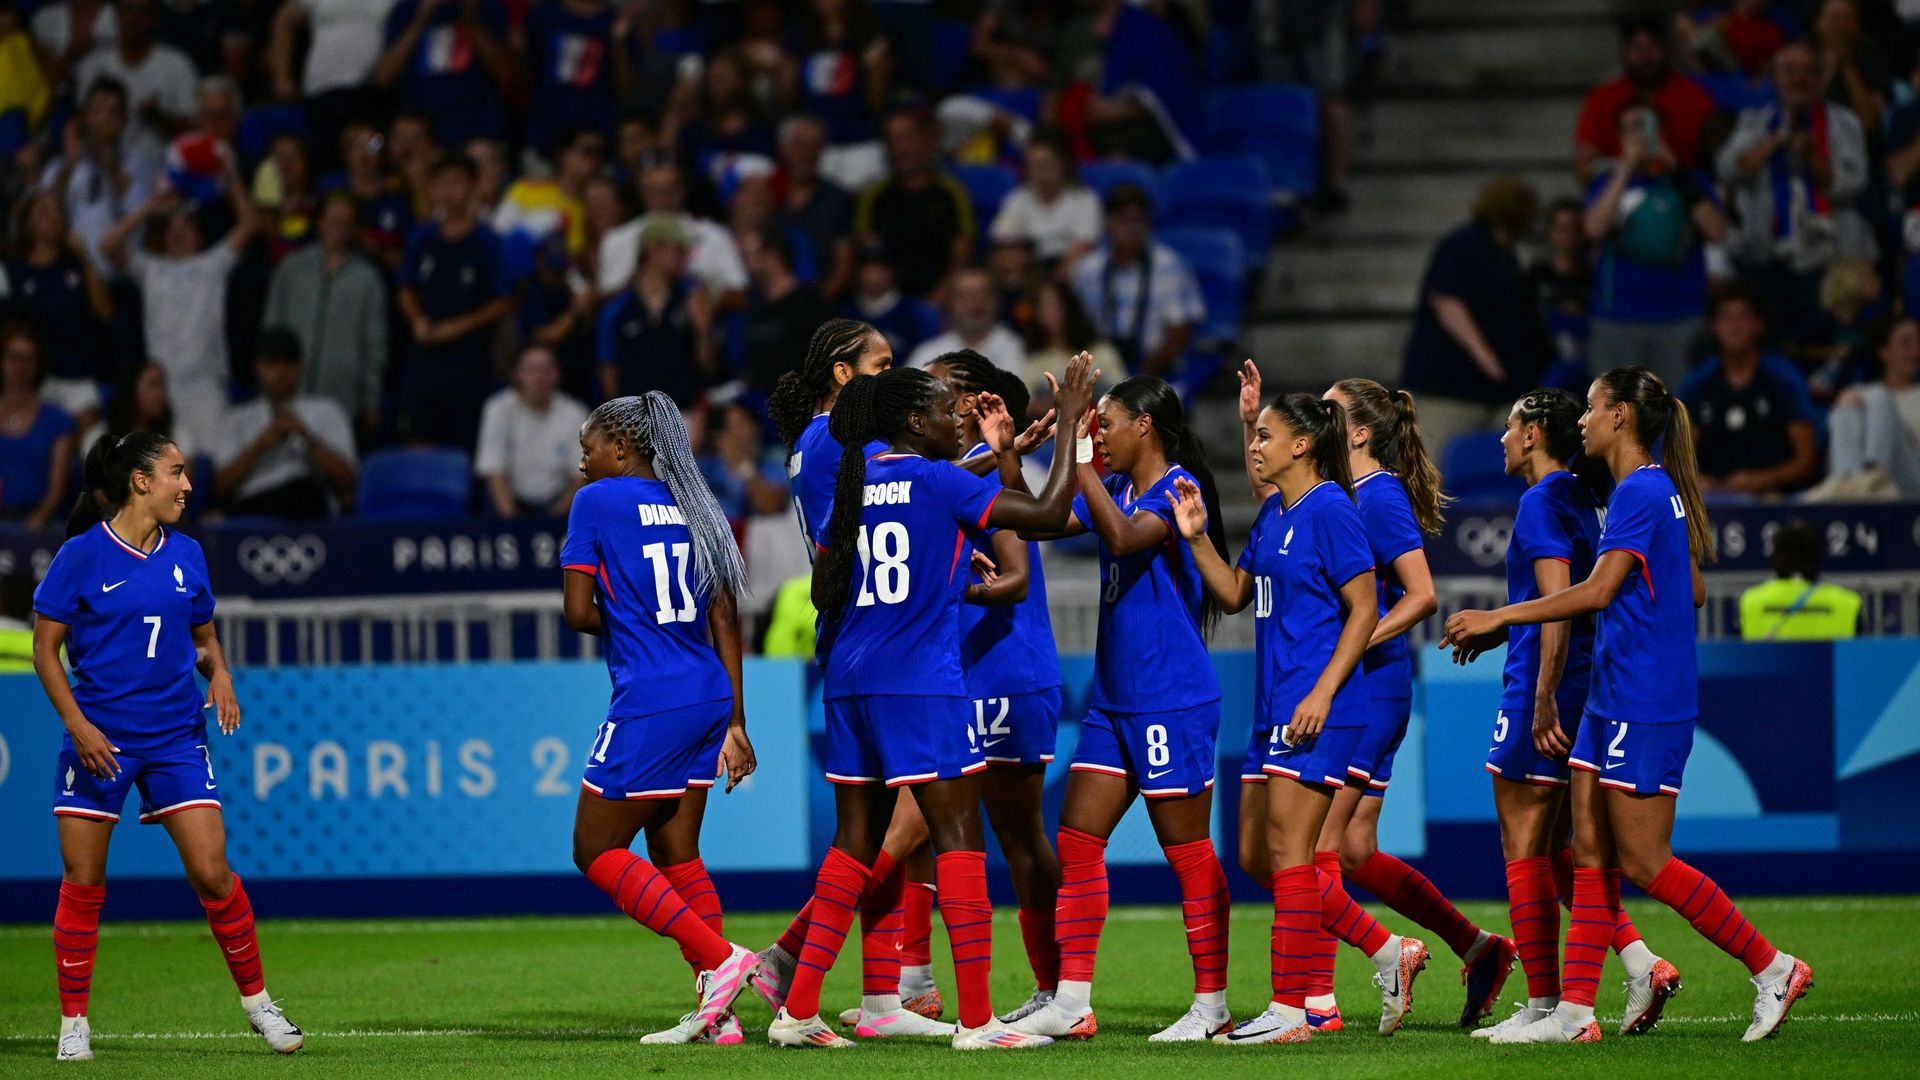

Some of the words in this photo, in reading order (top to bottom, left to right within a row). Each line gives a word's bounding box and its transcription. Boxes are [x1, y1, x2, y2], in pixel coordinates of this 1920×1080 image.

[862, 480, 912, 507] BOCK
[638, 503, 687, 526] DIAN
[393, 533, 520, 573] PARIS
[1761, 520, 1878, 557] 224
[642, 542, 698, 625] 11
[856, 521, 911, 607] 18
[1104, 562, 1120, 603] 8
[1254, 575, 1273, 618] 10
[143, 615, 162, 658] 7
[972, 696, 1011, 736] 12
[1145, 724, 1170, 767] 8
[1607, 720, 1629, 758] 2
[252, 740, 497, 800] PARIS
